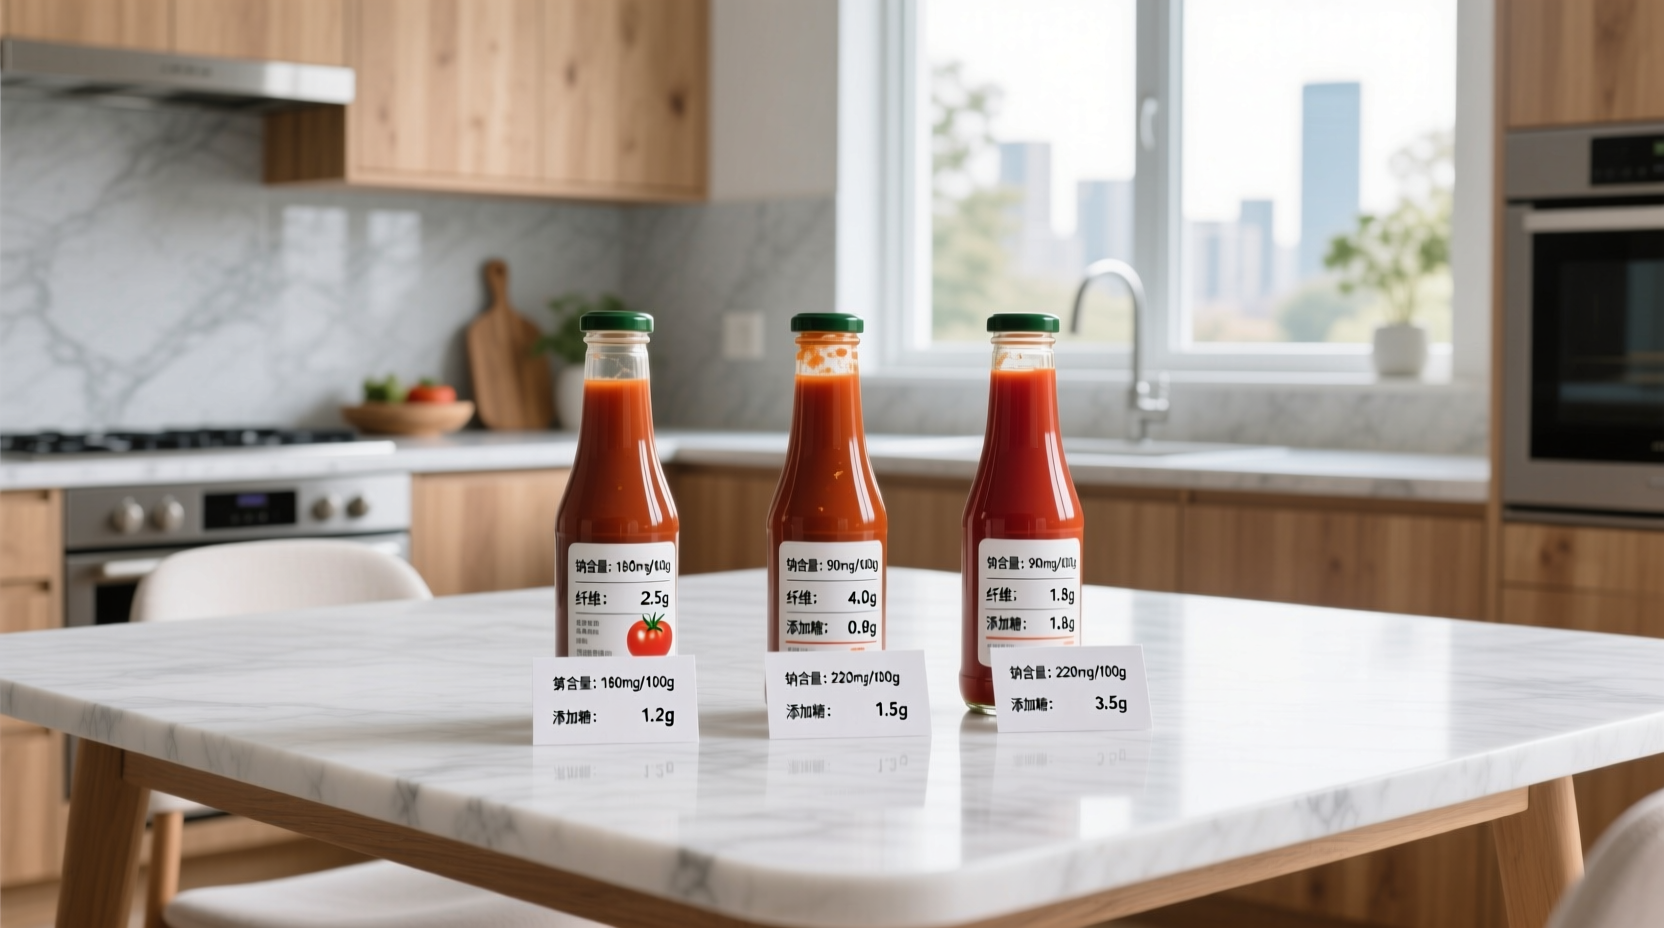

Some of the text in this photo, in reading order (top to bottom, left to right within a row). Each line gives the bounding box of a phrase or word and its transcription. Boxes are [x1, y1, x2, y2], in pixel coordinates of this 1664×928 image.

[640, 590, 669, 608] 2.5g
[848, 589, 877, 607] 4.0g
[1050, 615, 1075, 632] 1.8g
[875, 701, 908, 720] 1.5g
[1095, 695, 1127, 713] 3.5g
[641, 707, 675, 727] 1.2g
